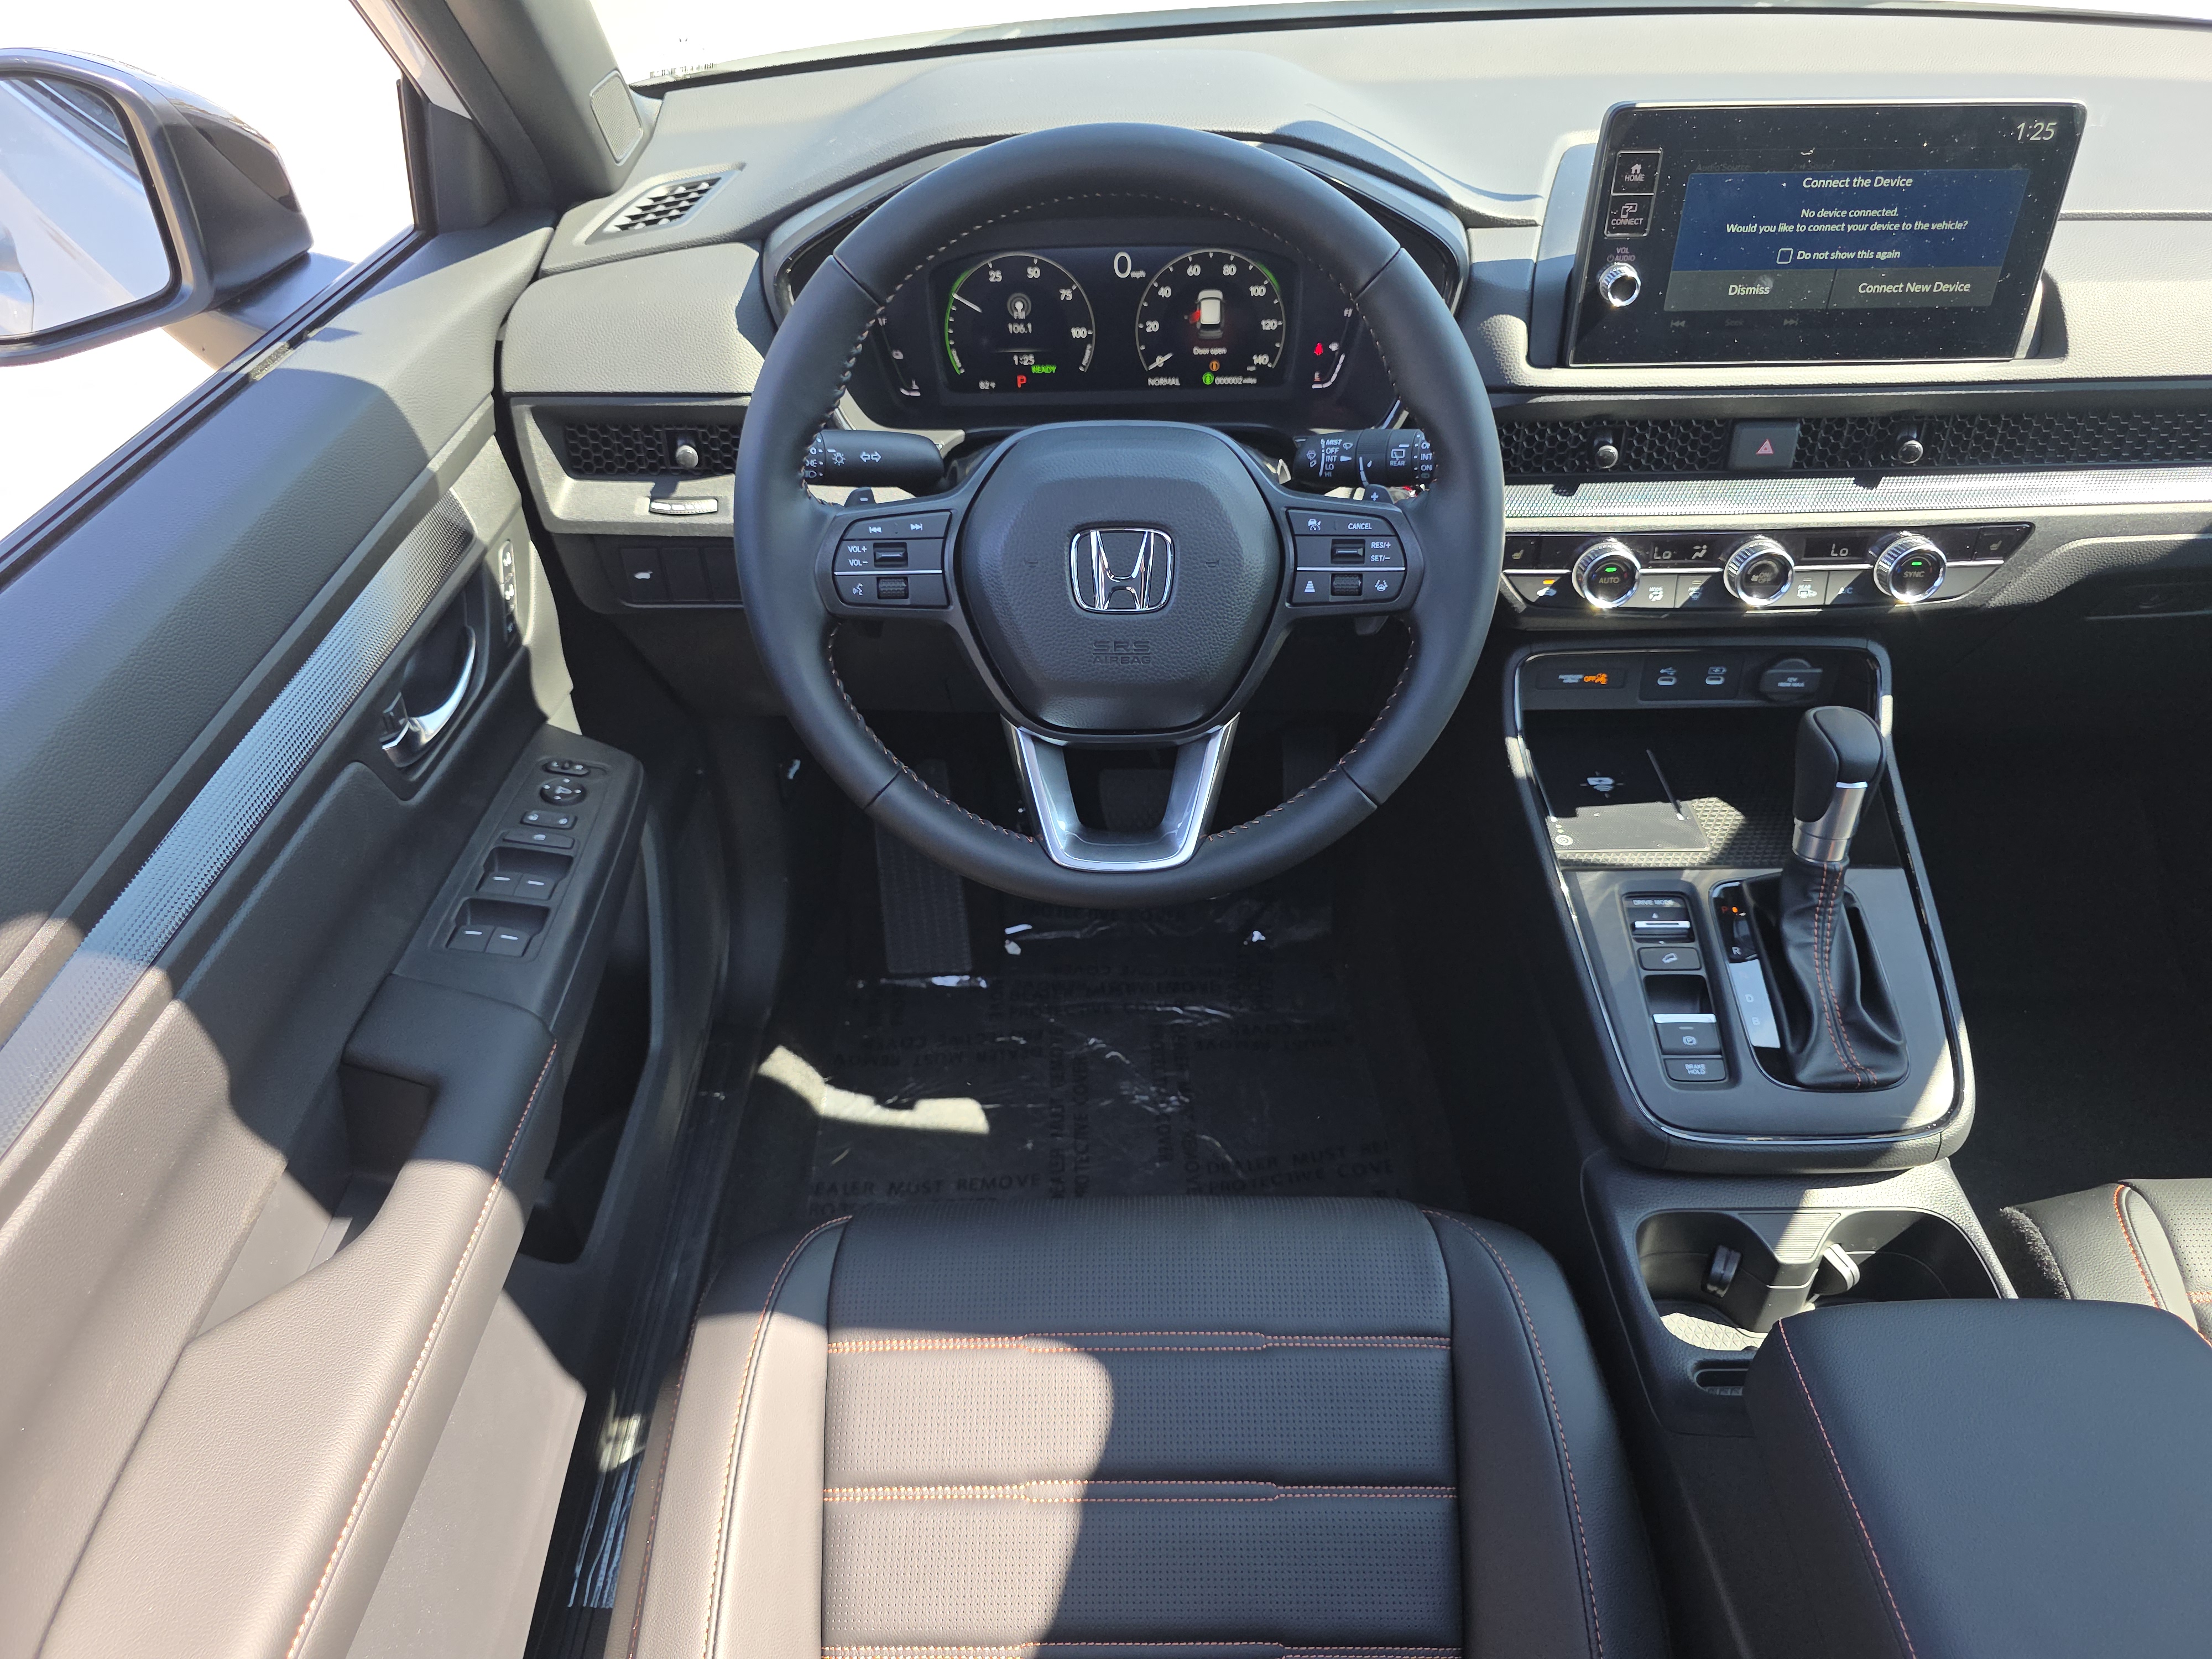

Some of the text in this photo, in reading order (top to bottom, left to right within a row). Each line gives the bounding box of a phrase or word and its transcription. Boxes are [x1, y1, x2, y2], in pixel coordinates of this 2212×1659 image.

[2016, 122, 2057, 141] 1:25
[1625, 174, 1645, 182] HOME
[1803, 176, 1913, 189] Connect the Device
[1801, 207, 1899, 218] No device connected.
[1726, 220, 1968, 234] Would you like to connect your device to the vehicle?
[1797, 249, 1901, 260] Do not show this again
[1114, 252, 1132, 278] 0
[1187, 264, 1201, 276] 60
[1223, 264, 1237, 275] 80
[988, 270, 1003, 282] 25
[1027, 267, 1041, 279] 50
[1158, 286, 1172, 298] 40
[1249, 285, 1266, 296] 100
[1728, 284, 1770, 295] Dismiss
[1858, 281, 1971, 293] Connect New Device
[1059, 288, 1073, 301] 75
[1013, 310, 1026, 320] FM
[1008, 322, 1032, 333] 106.1
[1145, 320, 1160, 332] 20
[1261, 319, 1278, 330] 120
[1071, 326, 1087, 338] 100
[1193, 346, 1227, 356] Door open
[1013, 354, 1035, 366] 1:25
[1253, 354, 1269, 365] 140
[1031, 364, 1057, 374] READY
[1016, 374, 1027, 388] P
[1147, 377, 1181, 386] NORMAL
[1093, 640, 1151, 653] SRS
[1093, 656, 1151, 664] AIRBAG
[1731, 946, 1741, 956] R
[1745, 994, 1754, 1003] D
[1751, 1017, 1761, 1026] B
[886, 1179, 944, 1196] MUST
[956, 1173, 1041, 1192] REMOVE
